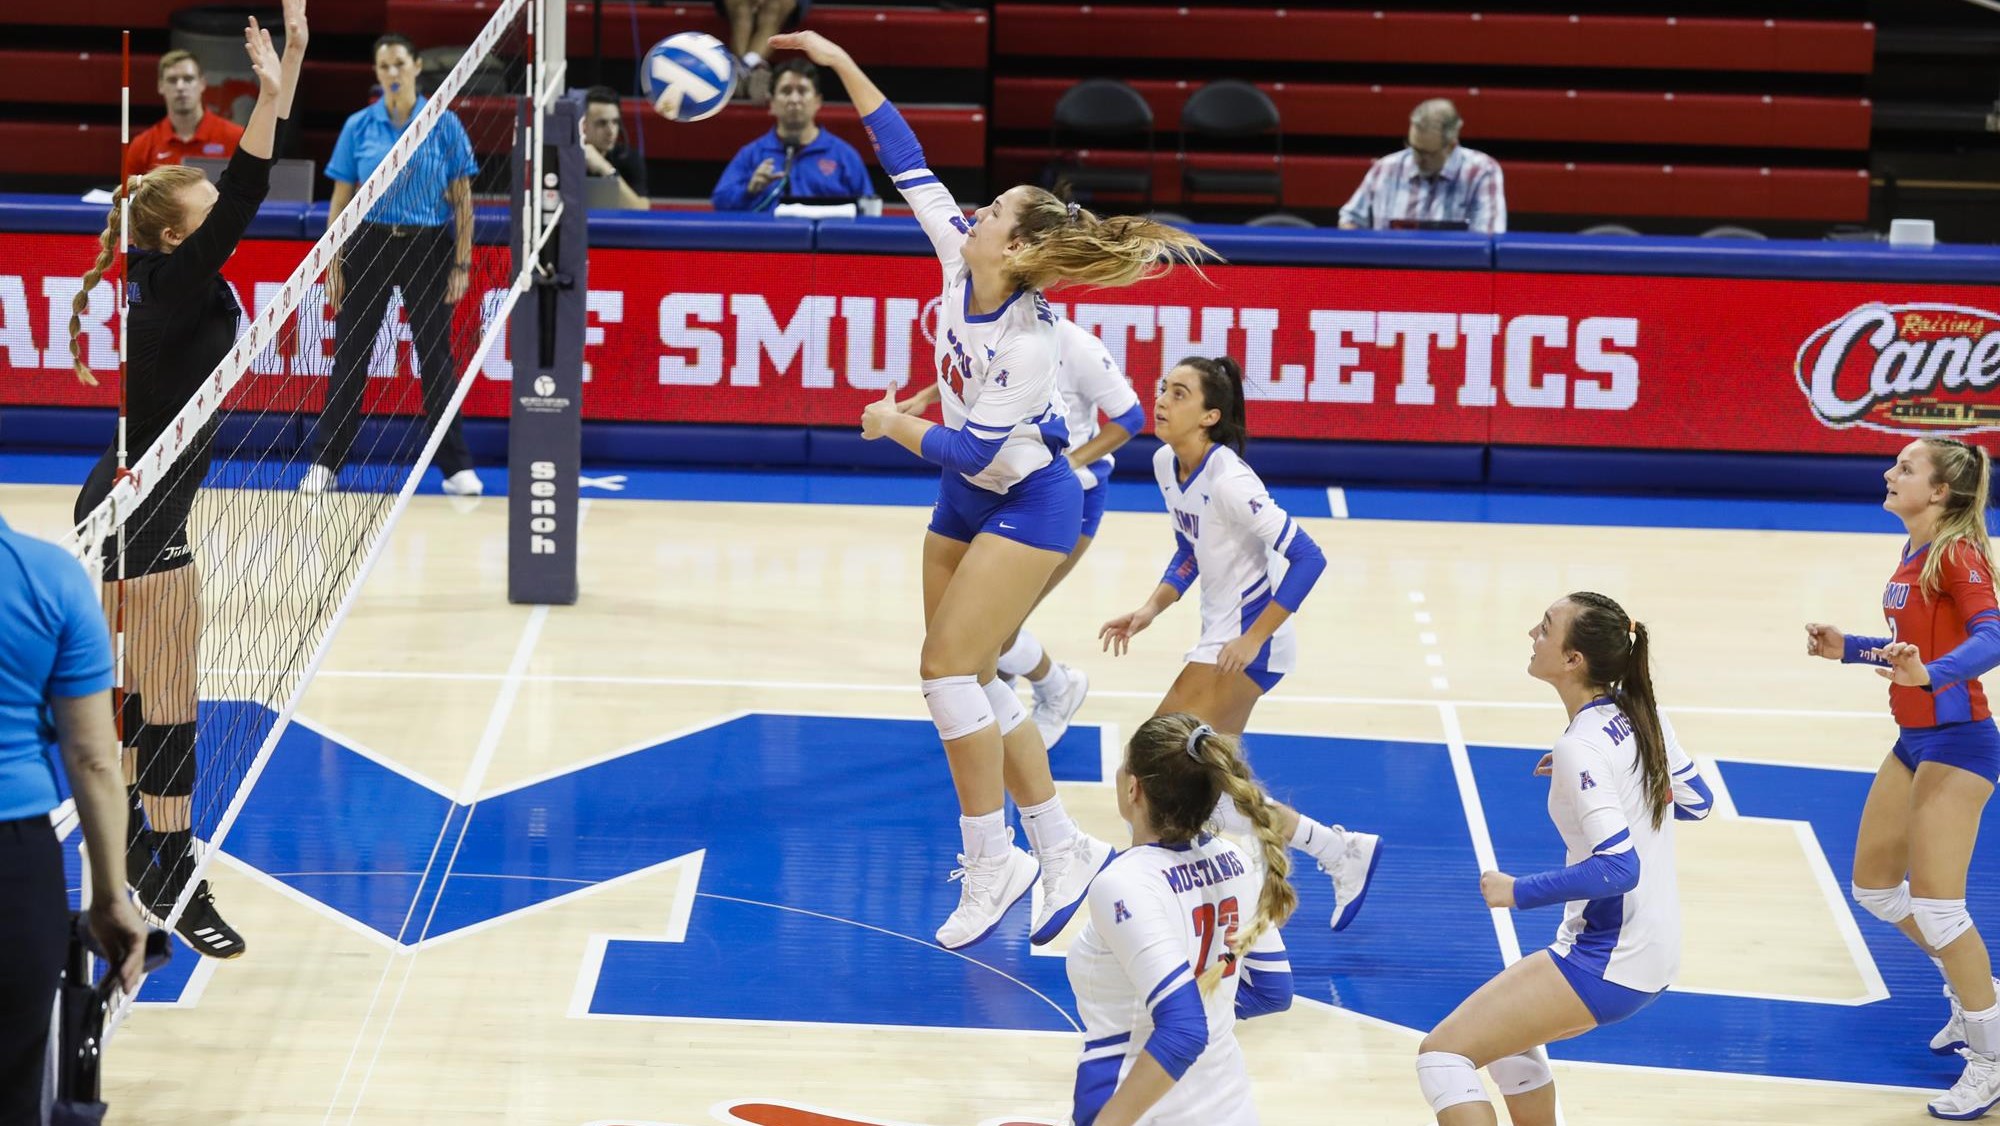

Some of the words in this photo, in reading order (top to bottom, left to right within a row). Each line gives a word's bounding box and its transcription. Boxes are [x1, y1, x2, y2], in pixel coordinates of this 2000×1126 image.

[658, 292, 919, 390] SMU
[1048, 302, 1640, 411] THLETICS
[530, 461, 556, 554] senoh
